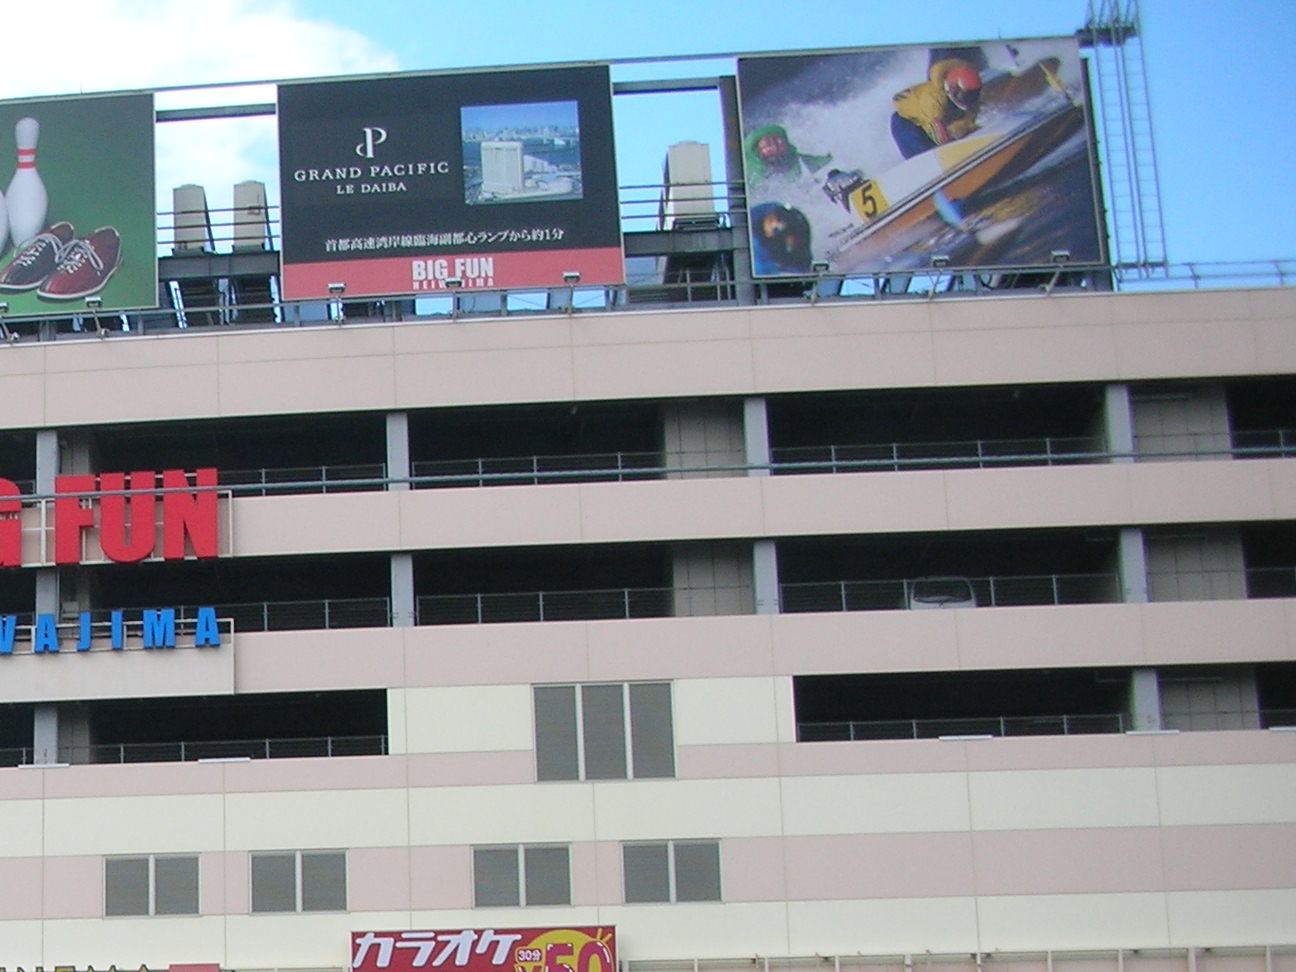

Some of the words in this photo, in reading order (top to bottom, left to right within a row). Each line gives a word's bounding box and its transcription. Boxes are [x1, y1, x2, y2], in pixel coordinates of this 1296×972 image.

[294, 166, 361, 182] GRAND
[370, 161, 449, 177] PACIFIC
[336, 184, 354, 195] LE
[361, 182, 407, 194] DAIBA
[412, 260, 448, 280] BIG
[455, 257, 493, 277] FUN
[55, 467, 218, 565] FUN
[353, 930, 522, 968] カラオケ
